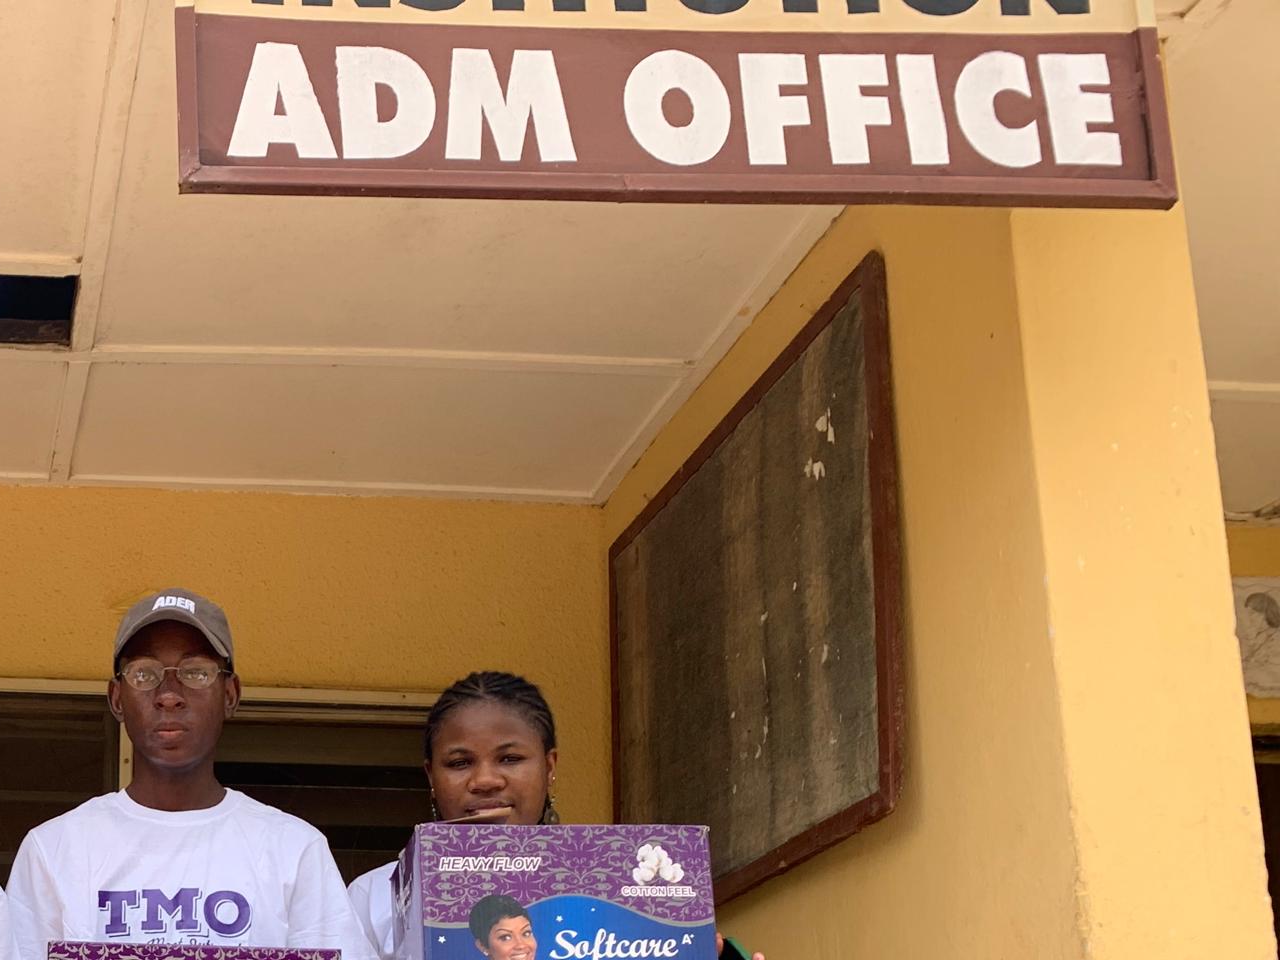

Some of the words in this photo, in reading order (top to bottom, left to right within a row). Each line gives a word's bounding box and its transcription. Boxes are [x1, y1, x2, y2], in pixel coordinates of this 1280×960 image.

[226, 42, 577, 164] ADM
[623, 50, 1122, 168] OFFICE
[152, 595, 195, 614] ADER
[439, 857, 492, 871] HEAVY
[492, 857, 541, 871] FLOW
[622, 886, 665, 897] COTTON
[666, 886, 696, 897] FEEL
[98, 888, 252, 938] TMO
